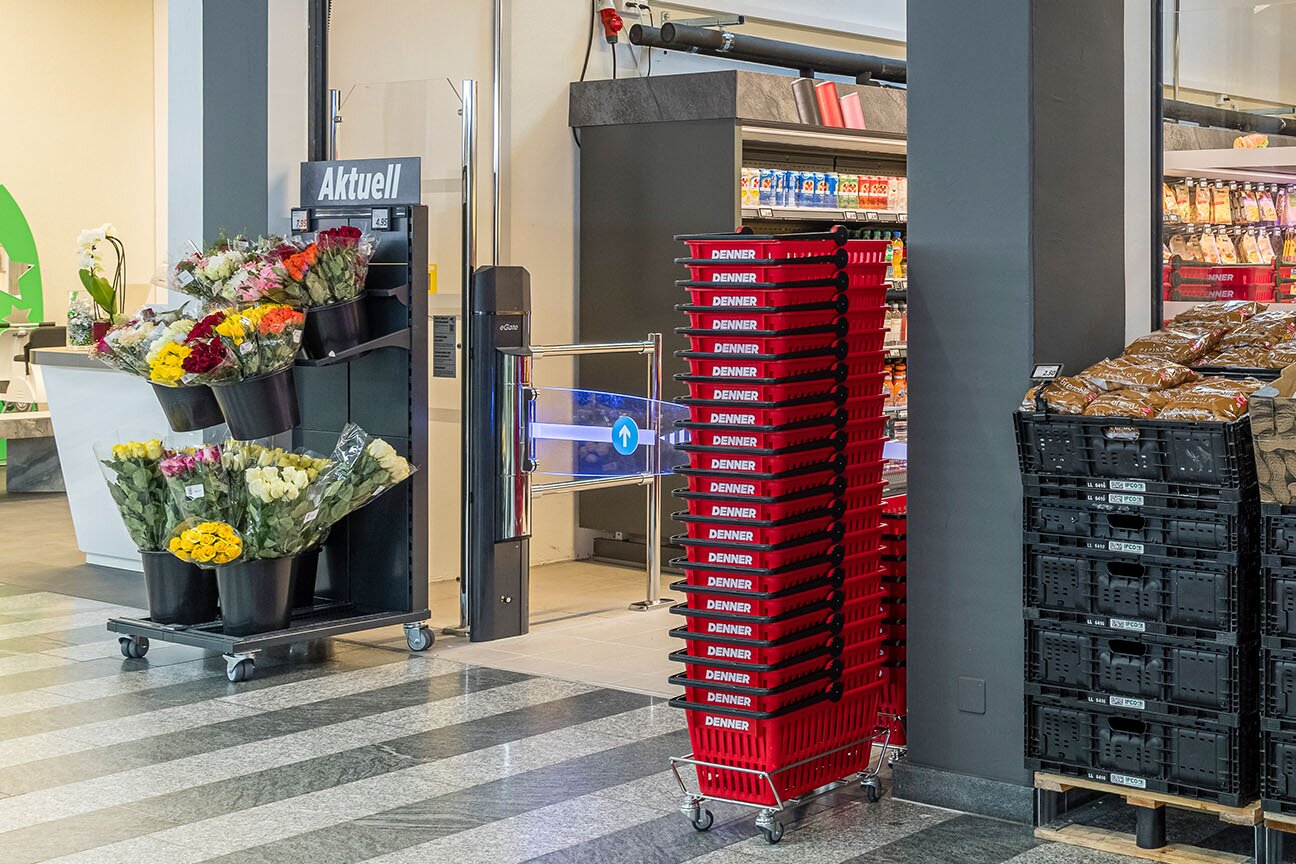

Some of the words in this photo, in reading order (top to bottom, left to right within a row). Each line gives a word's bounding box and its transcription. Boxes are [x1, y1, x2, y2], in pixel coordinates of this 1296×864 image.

[318, 164, 401, 200] Aktuell
[376, 218, 388, 226] 4.95
[712, 250, 755, 260] DENNER
[712, 273, 756, 283] DENNER
[713, 296, 757, 307] DENNER
[713, 320, 757, 331] DENNER
[714, 343, 758, 355] DENNER
[713, 367, 757, 378] DENNER
[714, 390, 758, 401] DENNER
[711, 414, 755, 425] DENNER
[713, 436, 757, 448] DENNER
[711, 460, 755, 471] DENNER
[710, 483, 755, 495] DENNER
[712, 506, 756, 519] DENNER
[709, 529, 753, 541] DENNER
[708, 553, 752, 565] DENNER
[708, 577, 752, 589] DENNER
[707, 600, 751, 613] DENNER
[708, 623, 752, 636] DENNER
[708, 646, 751, 660] DENNER
[706, 670, 750, 684] DENNER
[708, 692, 751, 707] DENNER
[705, 716, 749, 731] DENNER
